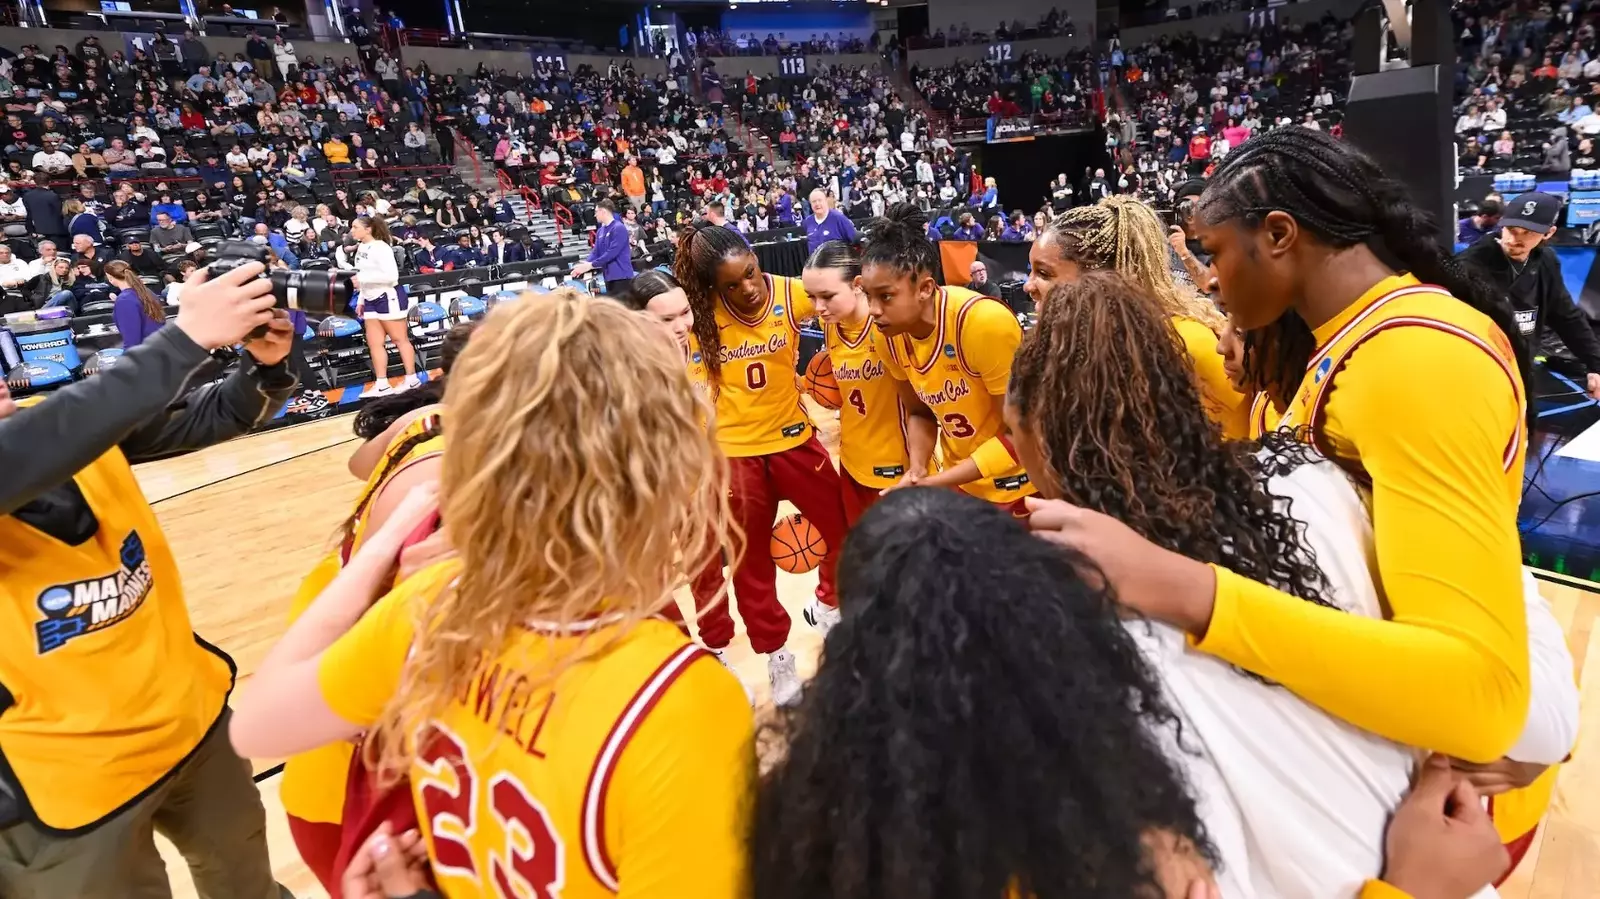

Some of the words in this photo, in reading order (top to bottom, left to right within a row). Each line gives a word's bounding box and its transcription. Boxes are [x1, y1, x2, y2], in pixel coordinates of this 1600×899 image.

[781, 58, 805, 74] 113
[21, 340, 67, 351] POWERADE
[719, 340, 766, 363] Southern
[768, 333, 787, 353] Cal
[745, 361, 767, 390] 0
[862, 359, 884, 381] Cal
[849, 388, 867, 416] 4
[944, 379, 970, 402] Cal
[414, 721, 565, 898] 23
